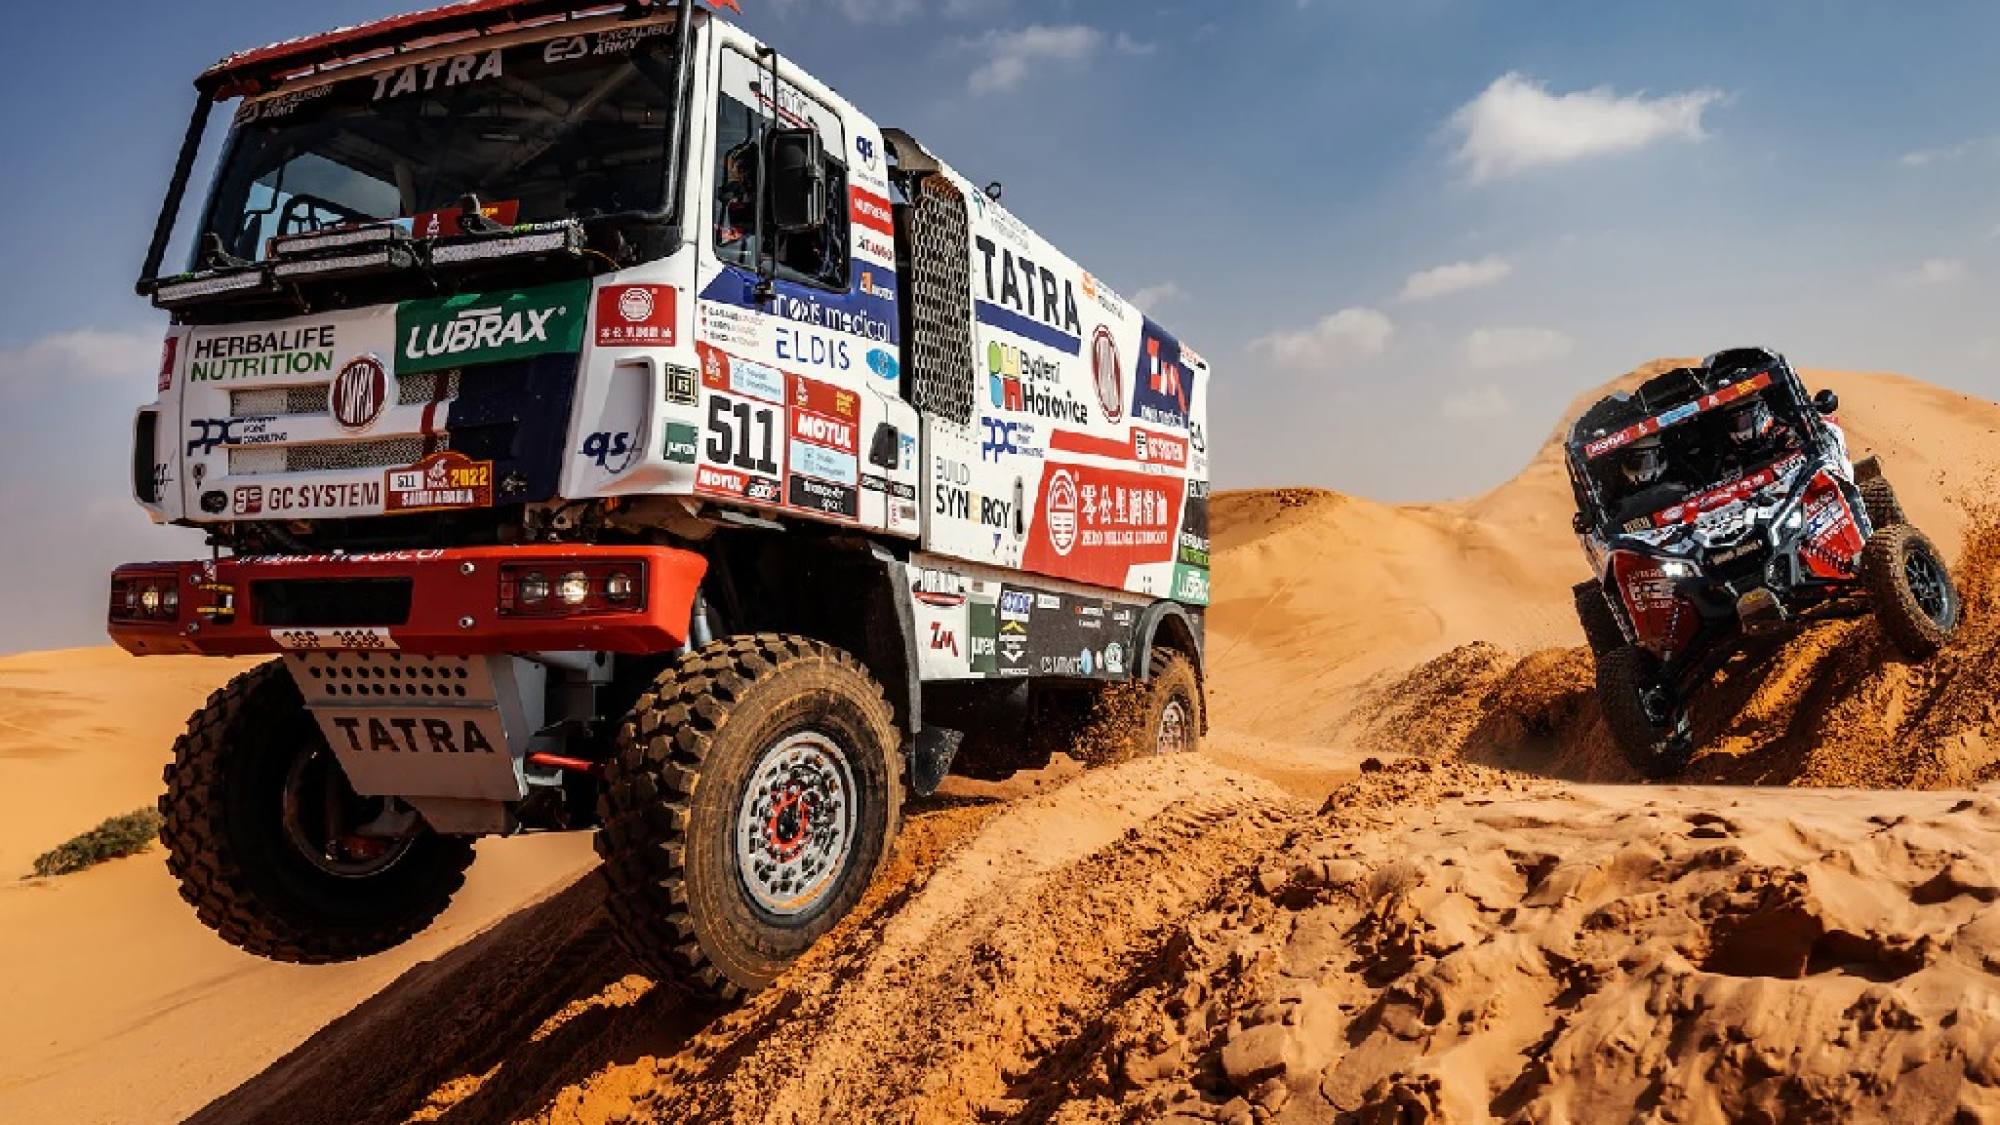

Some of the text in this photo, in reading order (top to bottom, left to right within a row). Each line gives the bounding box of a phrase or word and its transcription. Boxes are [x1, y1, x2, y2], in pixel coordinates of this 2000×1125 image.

[372, 50, 503, 101] TATRA
[975, 235, 1082, 337] TATRA
[195, 325, 336, 358] HERBALIFE
[404, 306, 556, 360] LUBRAX
[776, 327, 850, 370] ELDIS
[191, 350, 334, 382] NUTRITION
[706, 394, 778, 477] 511
[798, 412, 852, 449] MOTUL
[397, 475, 417, 488] 511
[451, 466, 489, 488] 2022
[700, 469, 744, 492] MOTUL
[936, 455, 970, 486] BUILD
[269, 481, 380, 510] GC SYSTEM
[936, 484, 1011, 529] SYNERGY
[335, 717, 496, 755] TATRA
